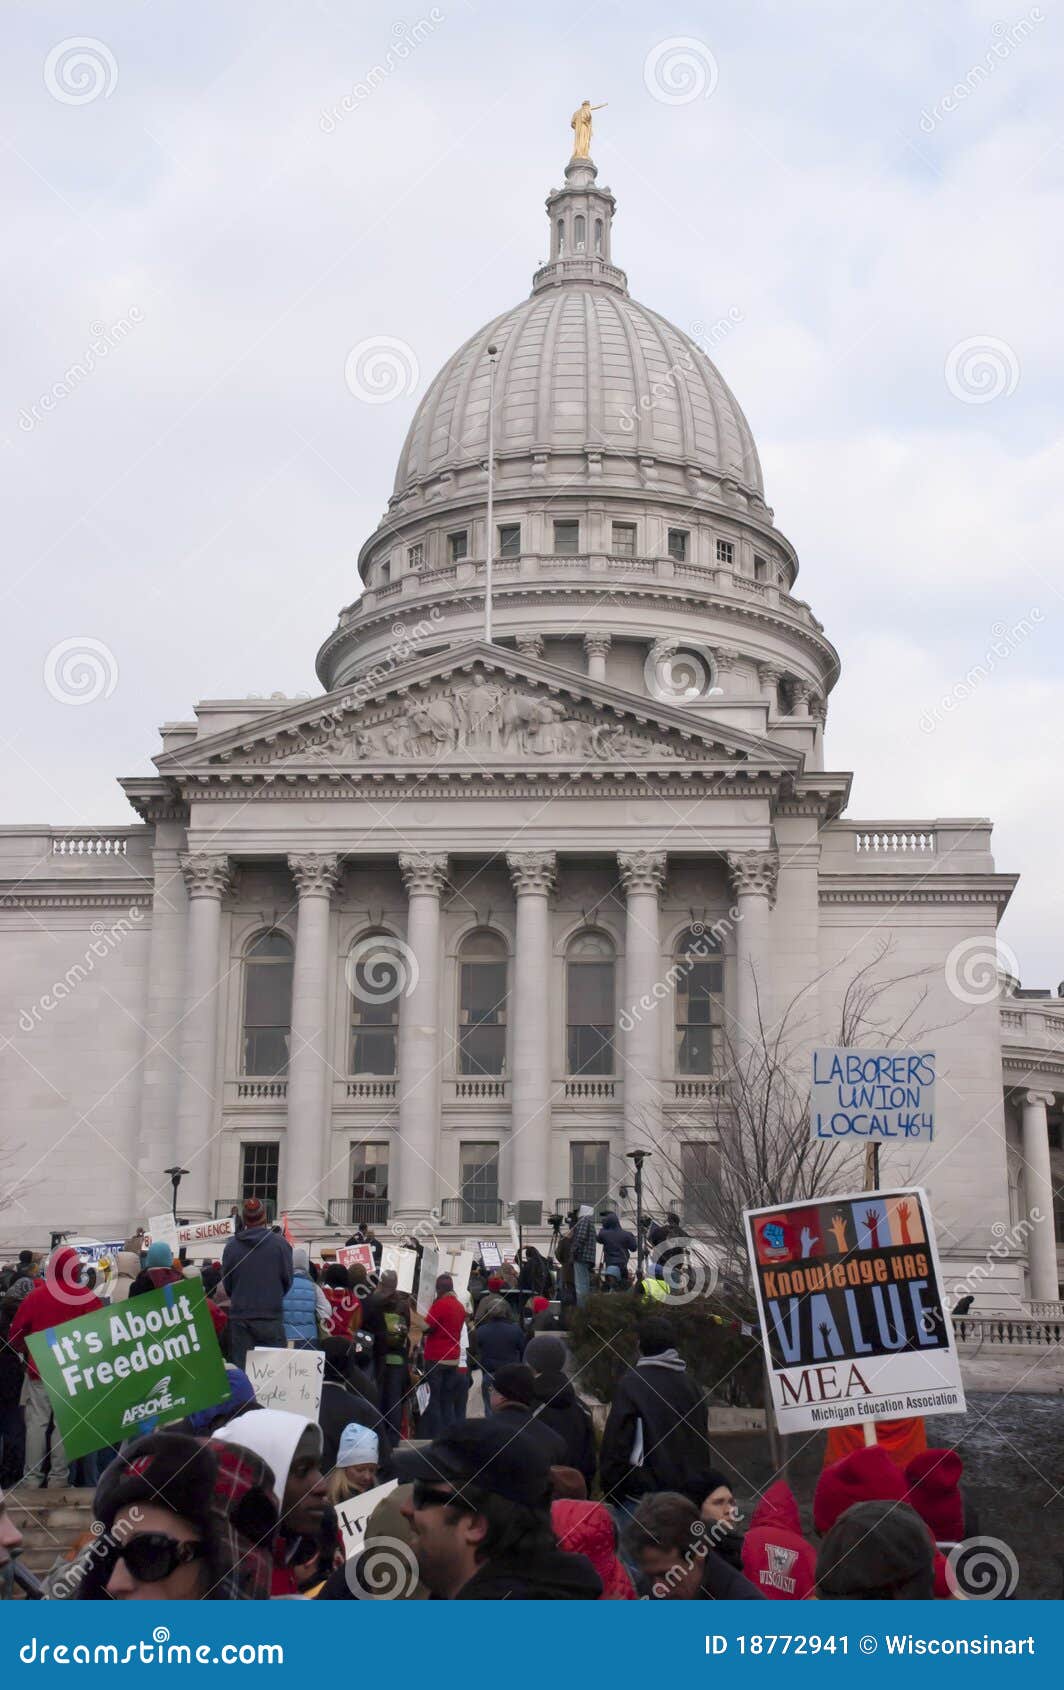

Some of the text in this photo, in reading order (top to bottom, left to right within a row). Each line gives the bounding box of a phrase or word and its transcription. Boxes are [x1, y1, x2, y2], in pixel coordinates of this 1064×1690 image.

[814, 1052, 936, 1086] LABORERS
[838, 1085, 920, 1110] UNION
[817, 1113, 898, 1138] LOCAL
[196, 1221, 231, 1239] SILENCE
[764, 1253, 929, 1298] Knowledge HAS
[109, 1295, 194, 1347] About
[768, 1281, 939, 1364] VALUE
[61, 1323, 201, 1397] Freedom!
[252, 1361, 275, 1380] We
[777, 1362, 873, 1406] MEA
[811, 1392, 958, 1422] Michigan Education Association
[760, 1570, 797, 1595] WISCONSIN
